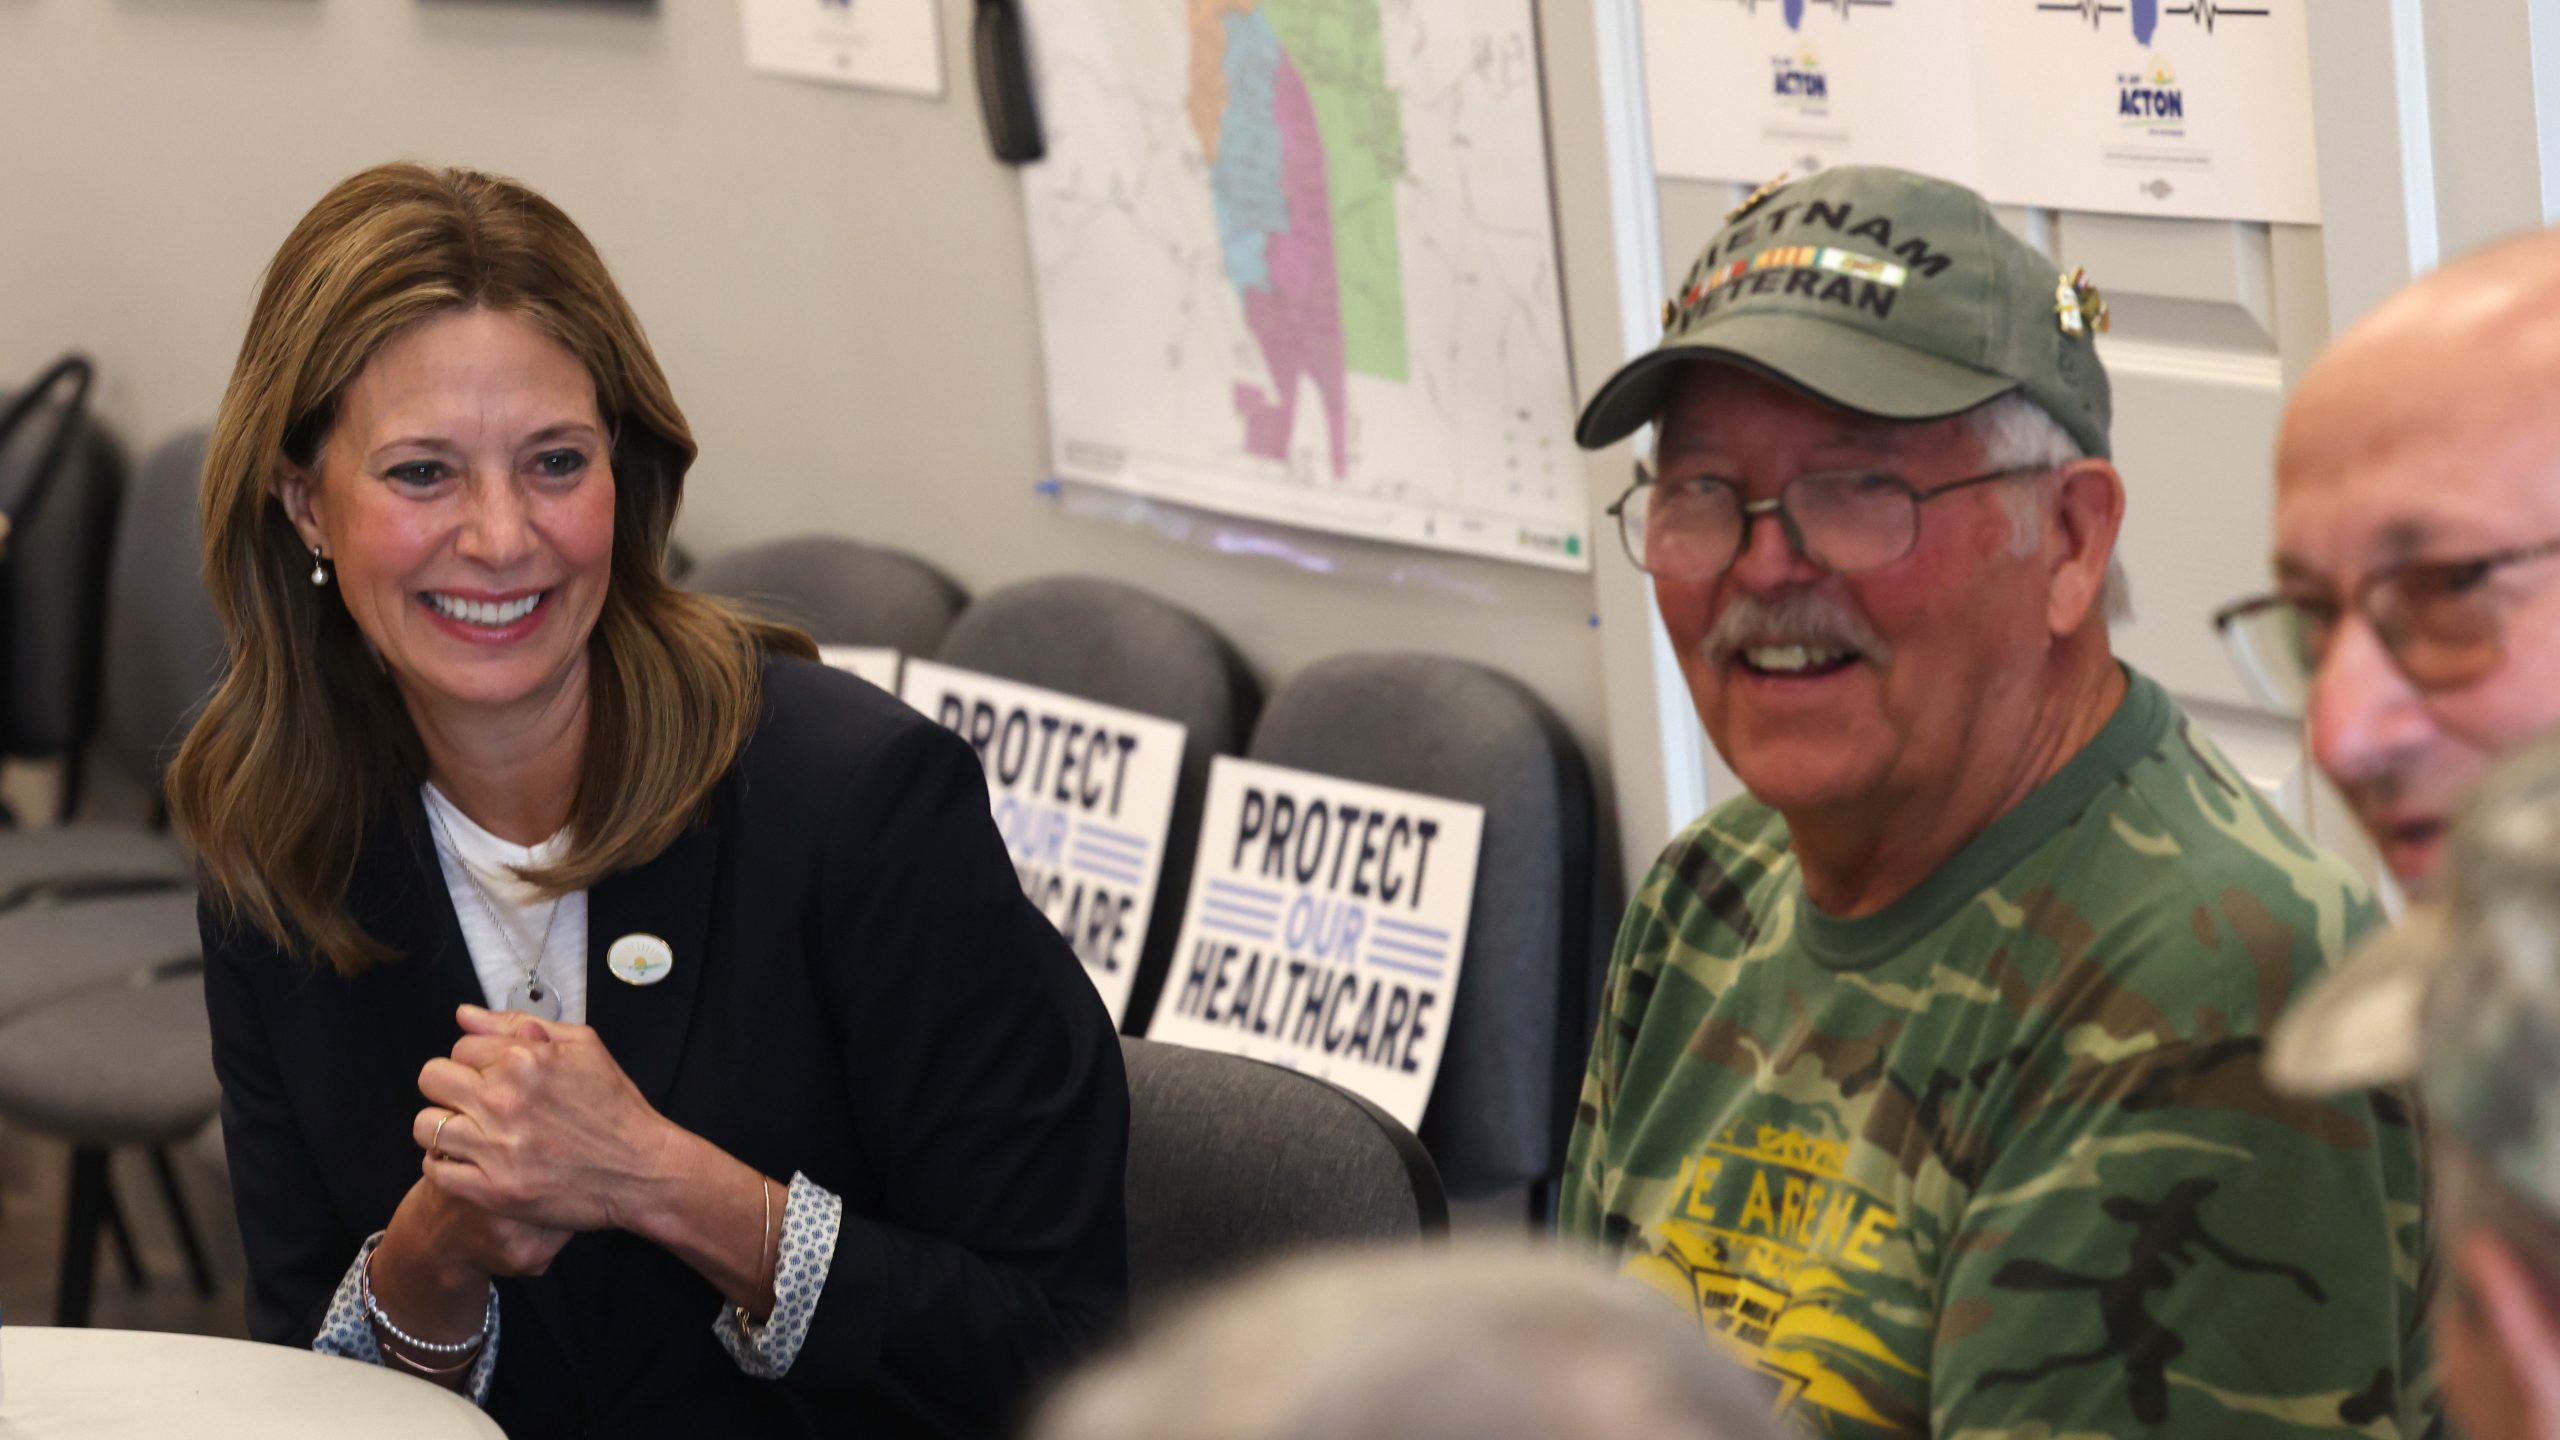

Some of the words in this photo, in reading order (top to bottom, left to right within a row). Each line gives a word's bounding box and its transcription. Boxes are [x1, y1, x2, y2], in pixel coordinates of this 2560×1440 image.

[2119, 87, 2184, 118] ACTON
[1232, 788, 1438, 909] PROTECT
[1285, 892, 1366, 966] OUR
[1174, 937, 1436, 1075] HEALTHCARE
